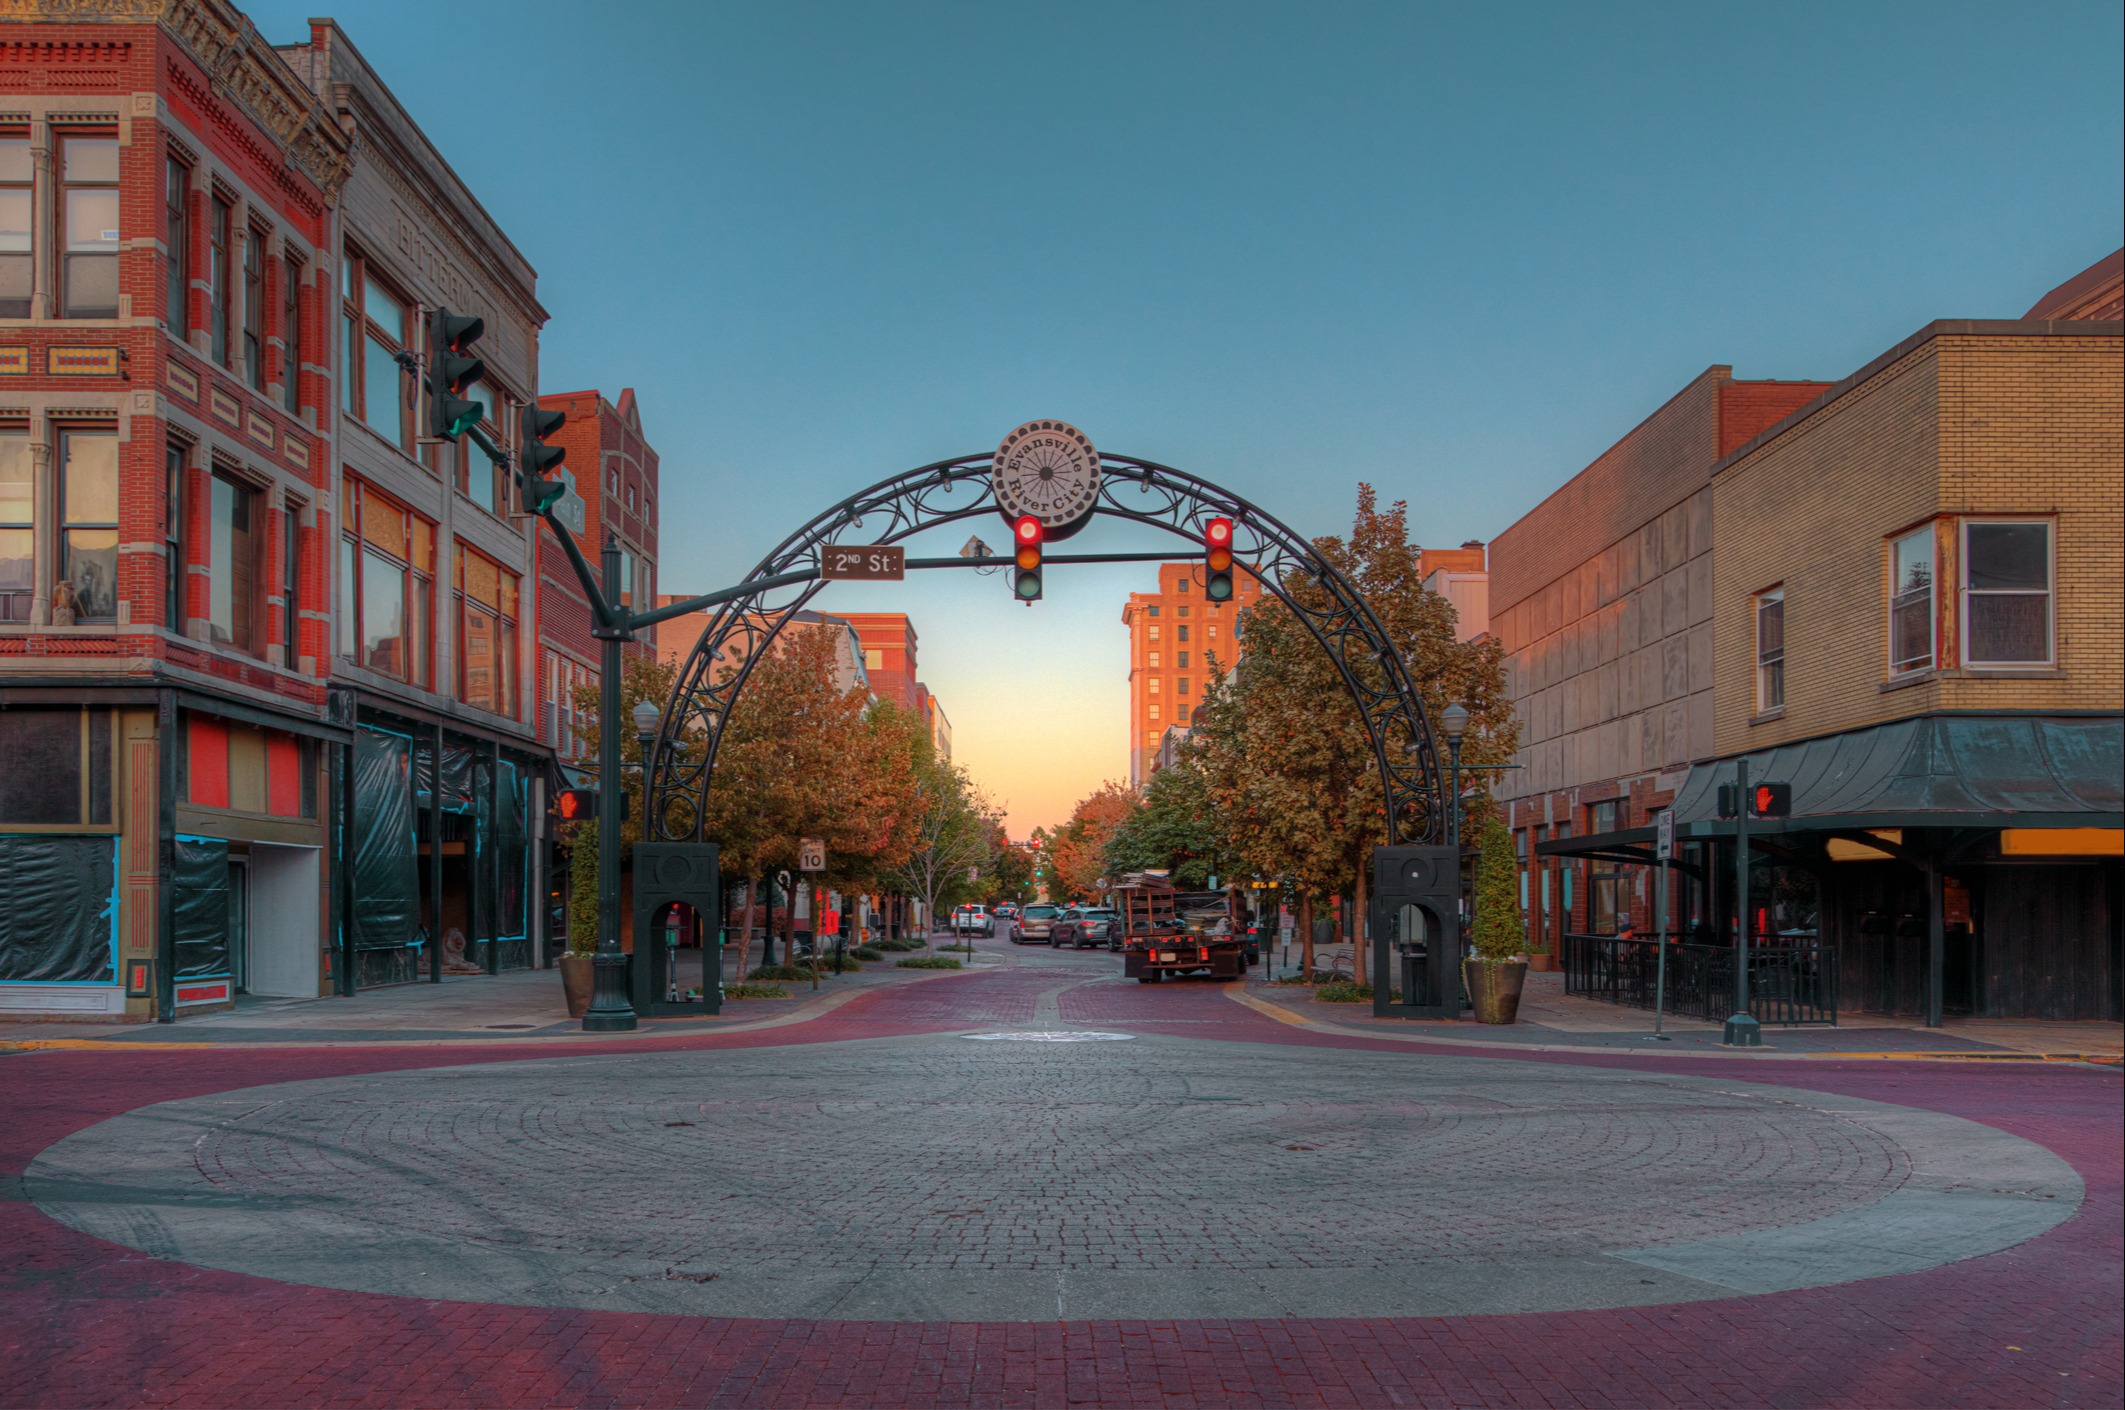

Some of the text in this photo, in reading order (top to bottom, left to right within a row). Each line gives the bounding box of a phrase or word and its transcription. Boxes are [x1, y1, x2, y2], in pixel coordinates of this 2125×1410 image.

[1008, 438, 1082, 473] Evansville
[1008, 477, 1085, 511] River City
[836, 554, 890, 572] 2ND St
[805, 855, 821, 867] 10
